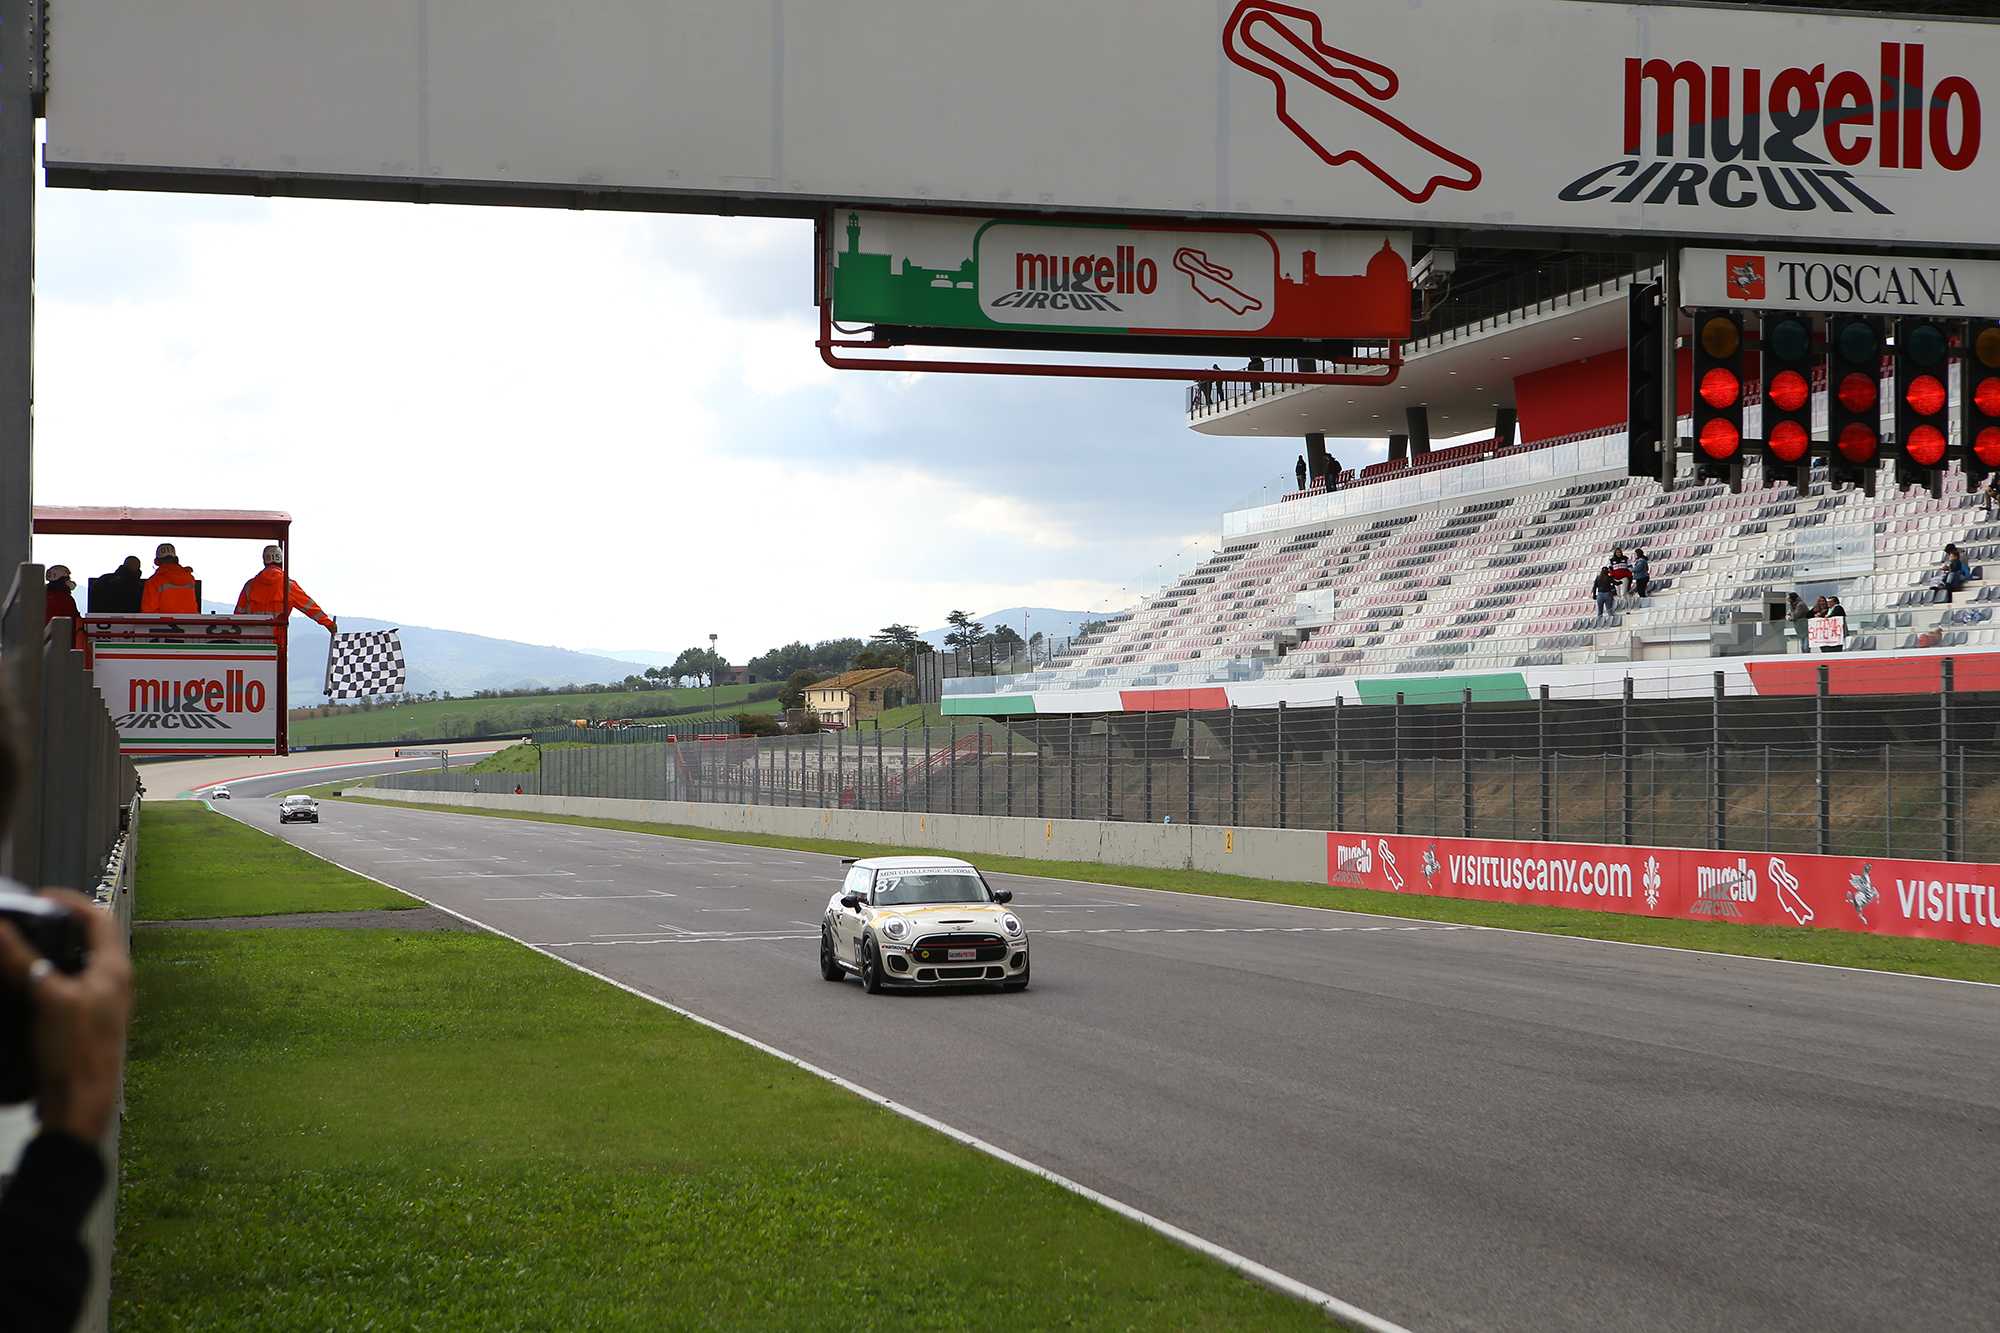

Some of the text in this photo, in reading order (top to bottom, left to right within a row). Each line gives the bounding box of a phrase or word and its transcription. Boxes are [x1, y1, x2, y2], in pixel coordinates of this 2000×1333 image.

[1624, 42, 1982, 171] mugello
[1558, 160, 1896, 215] CIRCUIT
[1016, 245, 1158, 295] mugello
[1778, 261, 1965, 307] TOSCANA
[991, 291, 1124, 312] CIRCUIT
[129, 669, 266, 714] mugello
[114, 713, 232, 729] CIRCUIT
[1337, 839, 1372, 874] mugello
[875, 877, 901, 893] 87
[1697, 858, 1757, 902] mugello
